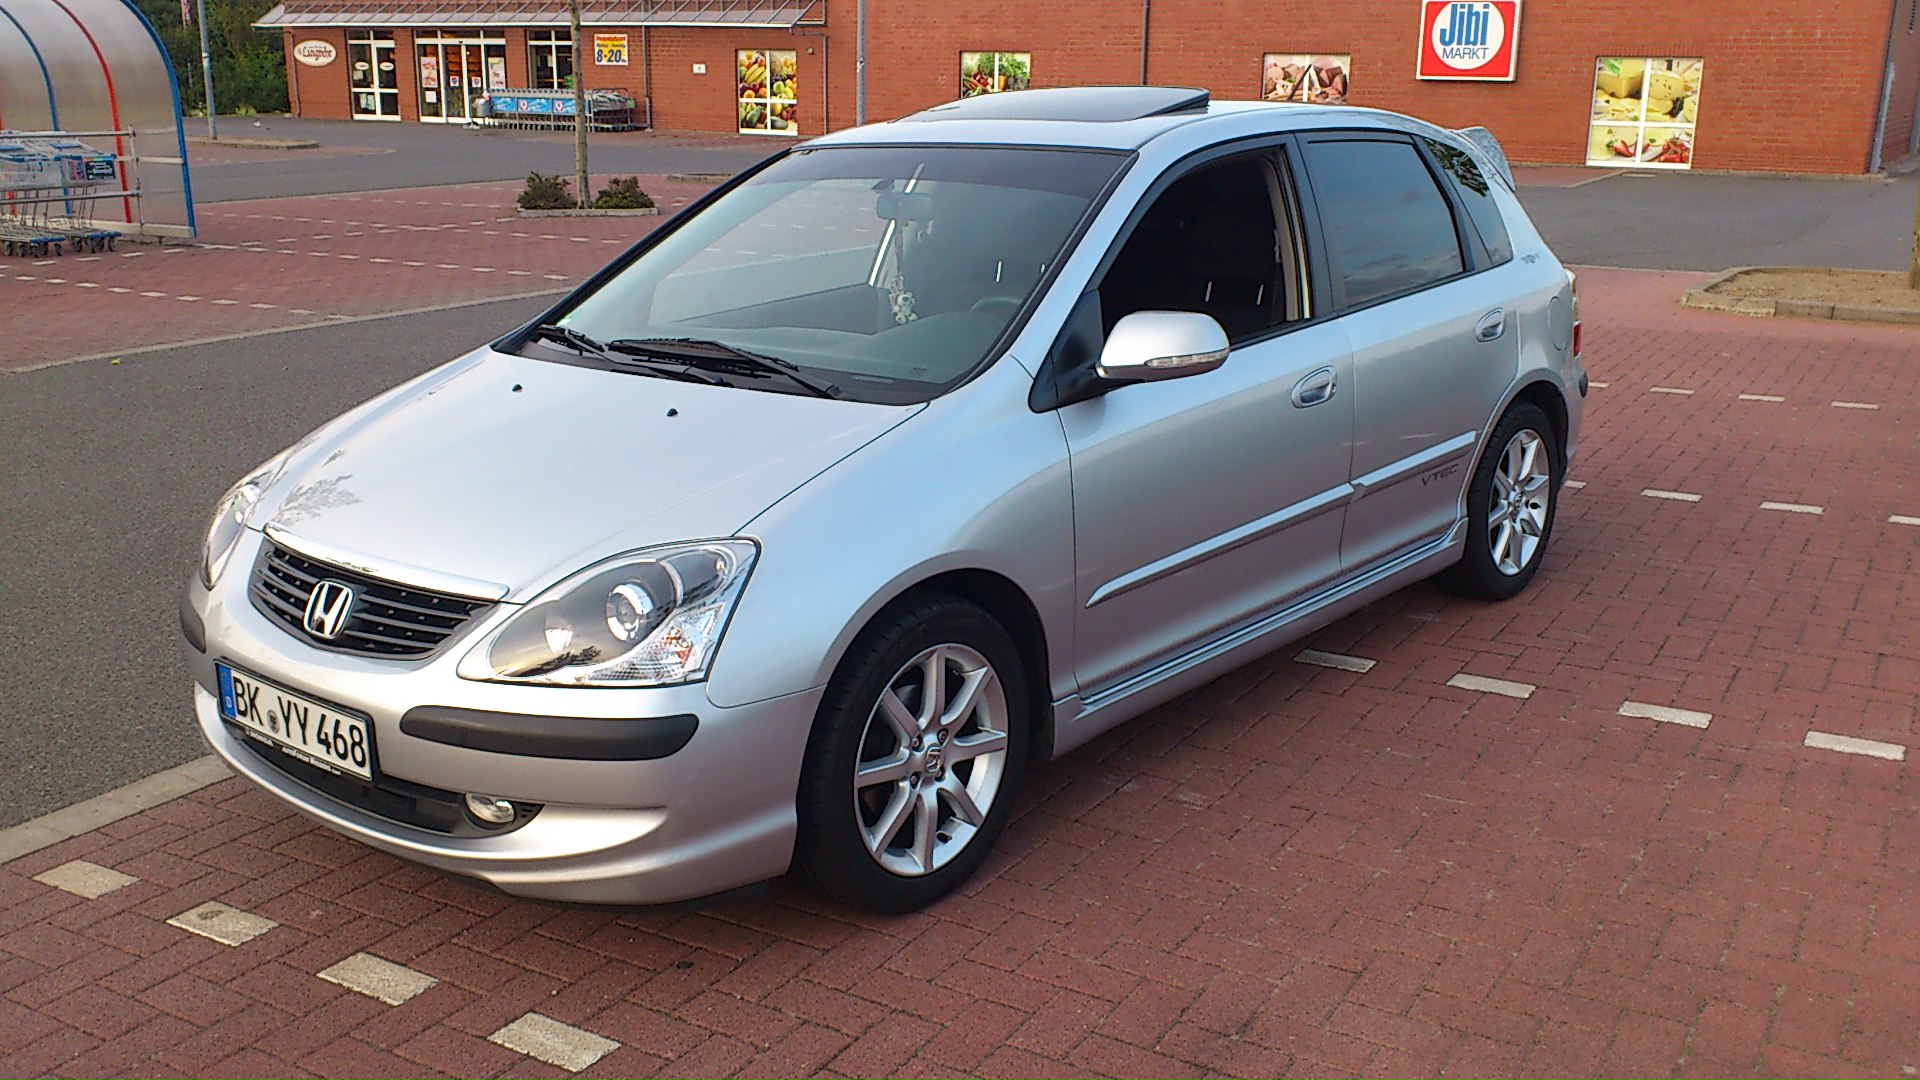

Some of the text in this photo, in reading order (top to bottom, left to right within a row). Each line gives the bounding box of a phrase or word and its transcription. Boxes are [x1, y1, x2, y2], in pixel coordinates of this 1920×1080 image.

[1439, 3, 1490, 47] Jibi
[1442, 47, 1490, 60] MARKT
[1421, 463, 1459, 487] VTEC
[233, 675, 264, 727] BK
[277, 695, 309, 746] YY
[316, 713, 367, 769] 468
